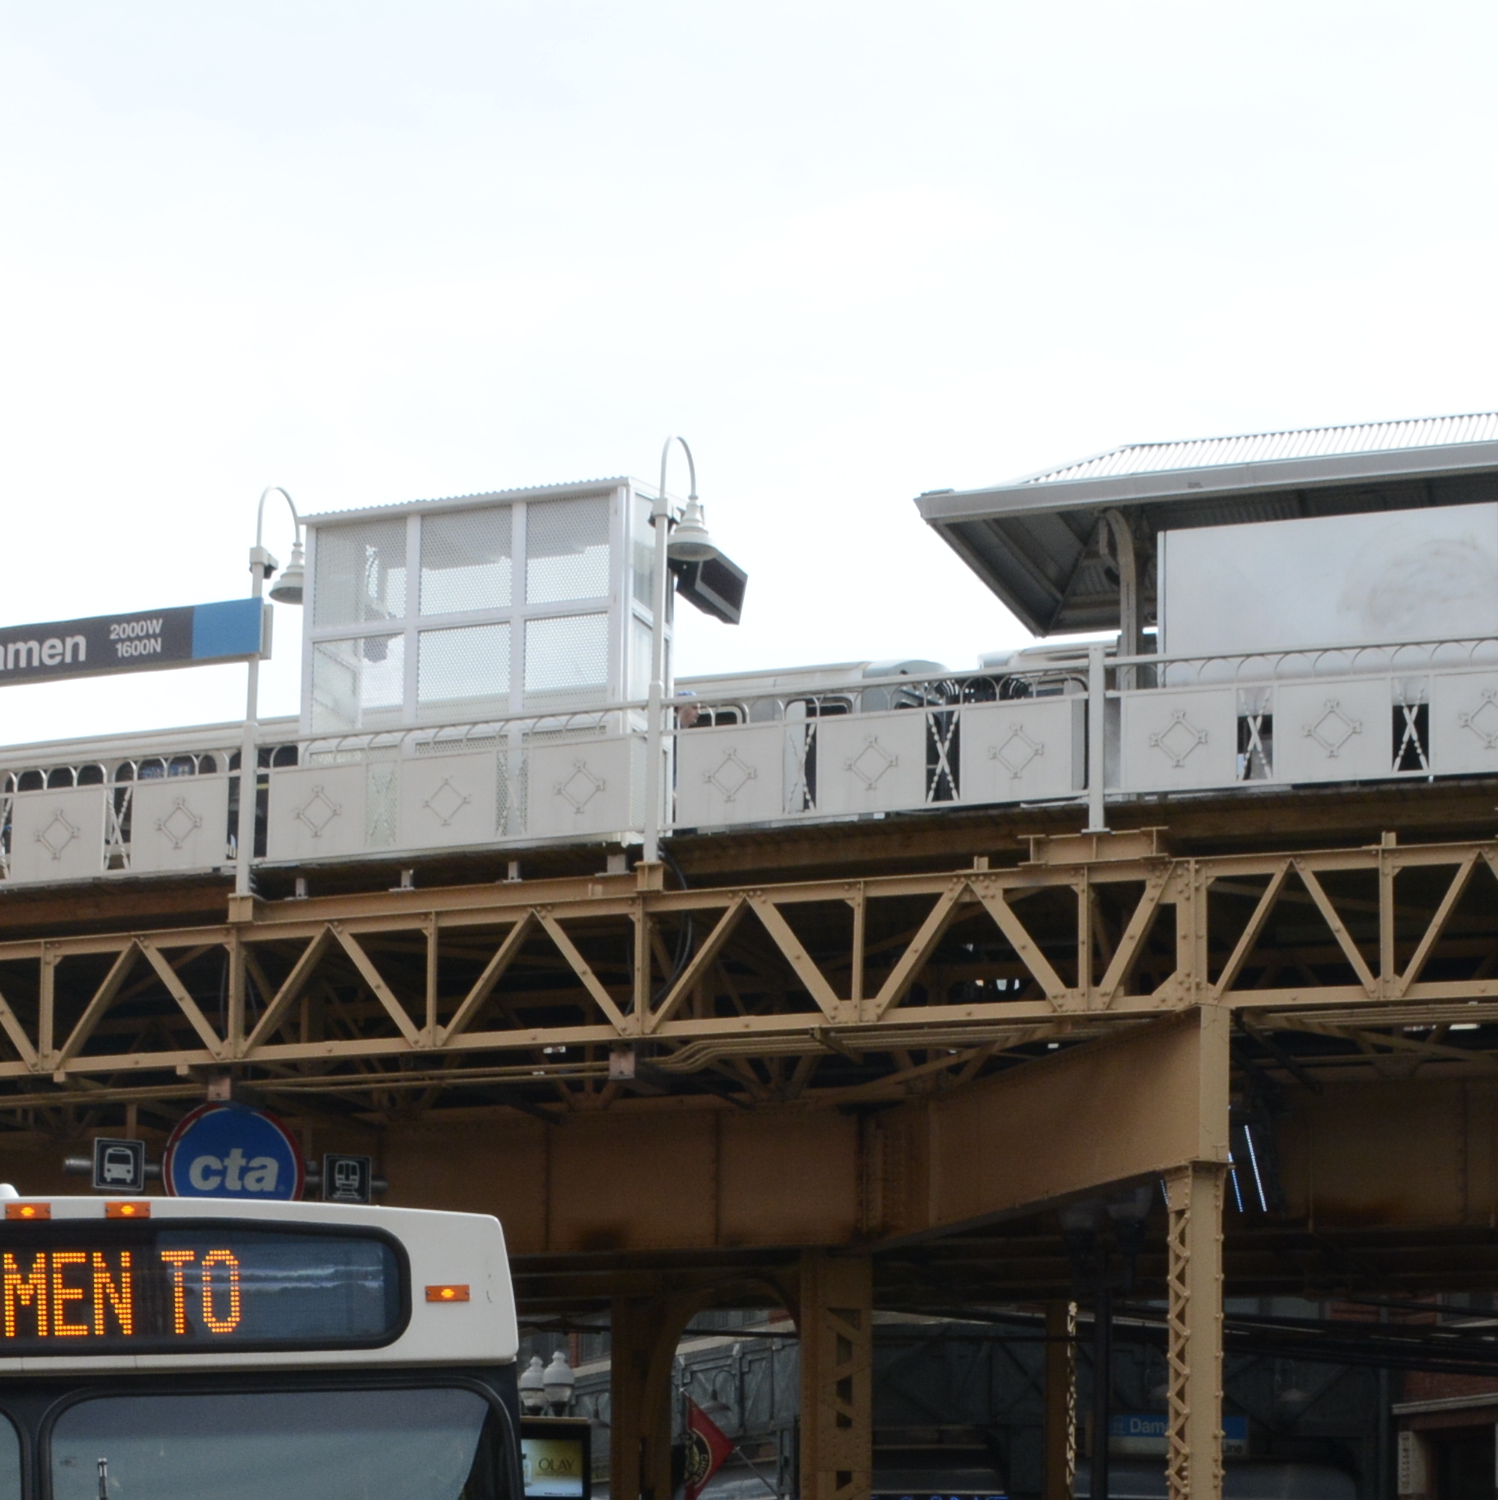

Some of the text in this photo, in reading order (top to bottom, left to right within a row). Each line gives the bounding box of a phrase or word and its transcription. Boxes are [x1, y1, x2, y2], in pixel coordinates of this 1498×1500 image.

[110, 618, 164, 640] 2000W
[115, 637, 161, 658] 1600N
[189, 1148, 279, 1193] cta
[159, 1248, 242, 1335] TO
[538, 1457, 575, 1471] OLAY
